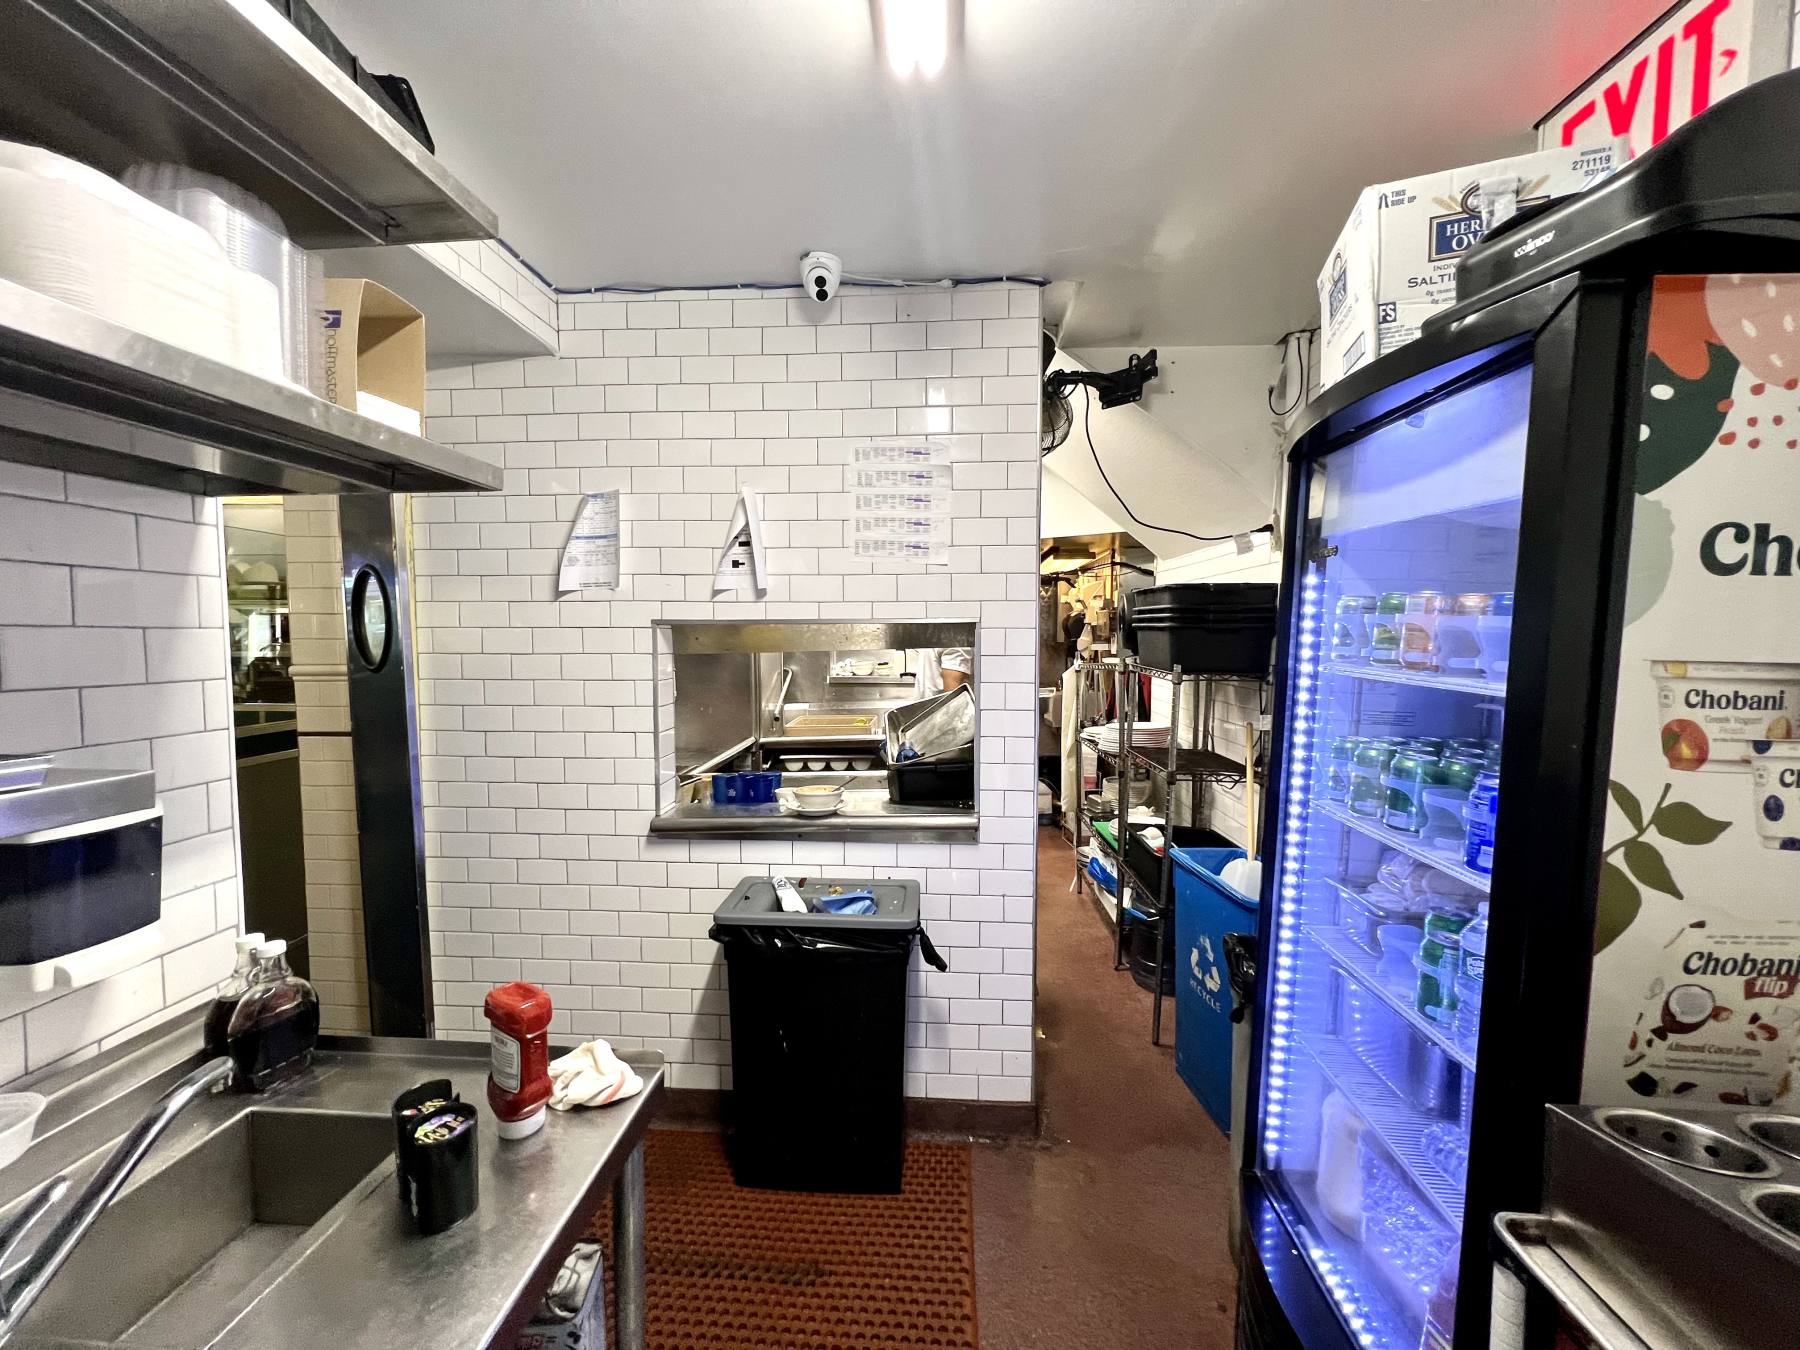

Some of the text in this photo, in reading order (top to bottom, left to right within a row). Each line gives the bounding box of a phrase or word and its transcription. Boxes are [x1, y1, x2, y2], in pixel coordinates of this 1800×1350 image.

[1572, 155, 1611, 170] 271119
[1391, 189, 1406, 198] THIS
[1391, 198, 1405, 206] SIDE
[1379, 305, 1395, 322] FS
[1700, 521, 1800, 576] Ch
[1685, 689, 1785, 710] Chobani
[1683, 951, 1800, 977] Chobani
[1754, 979, 1788, 995] flip
